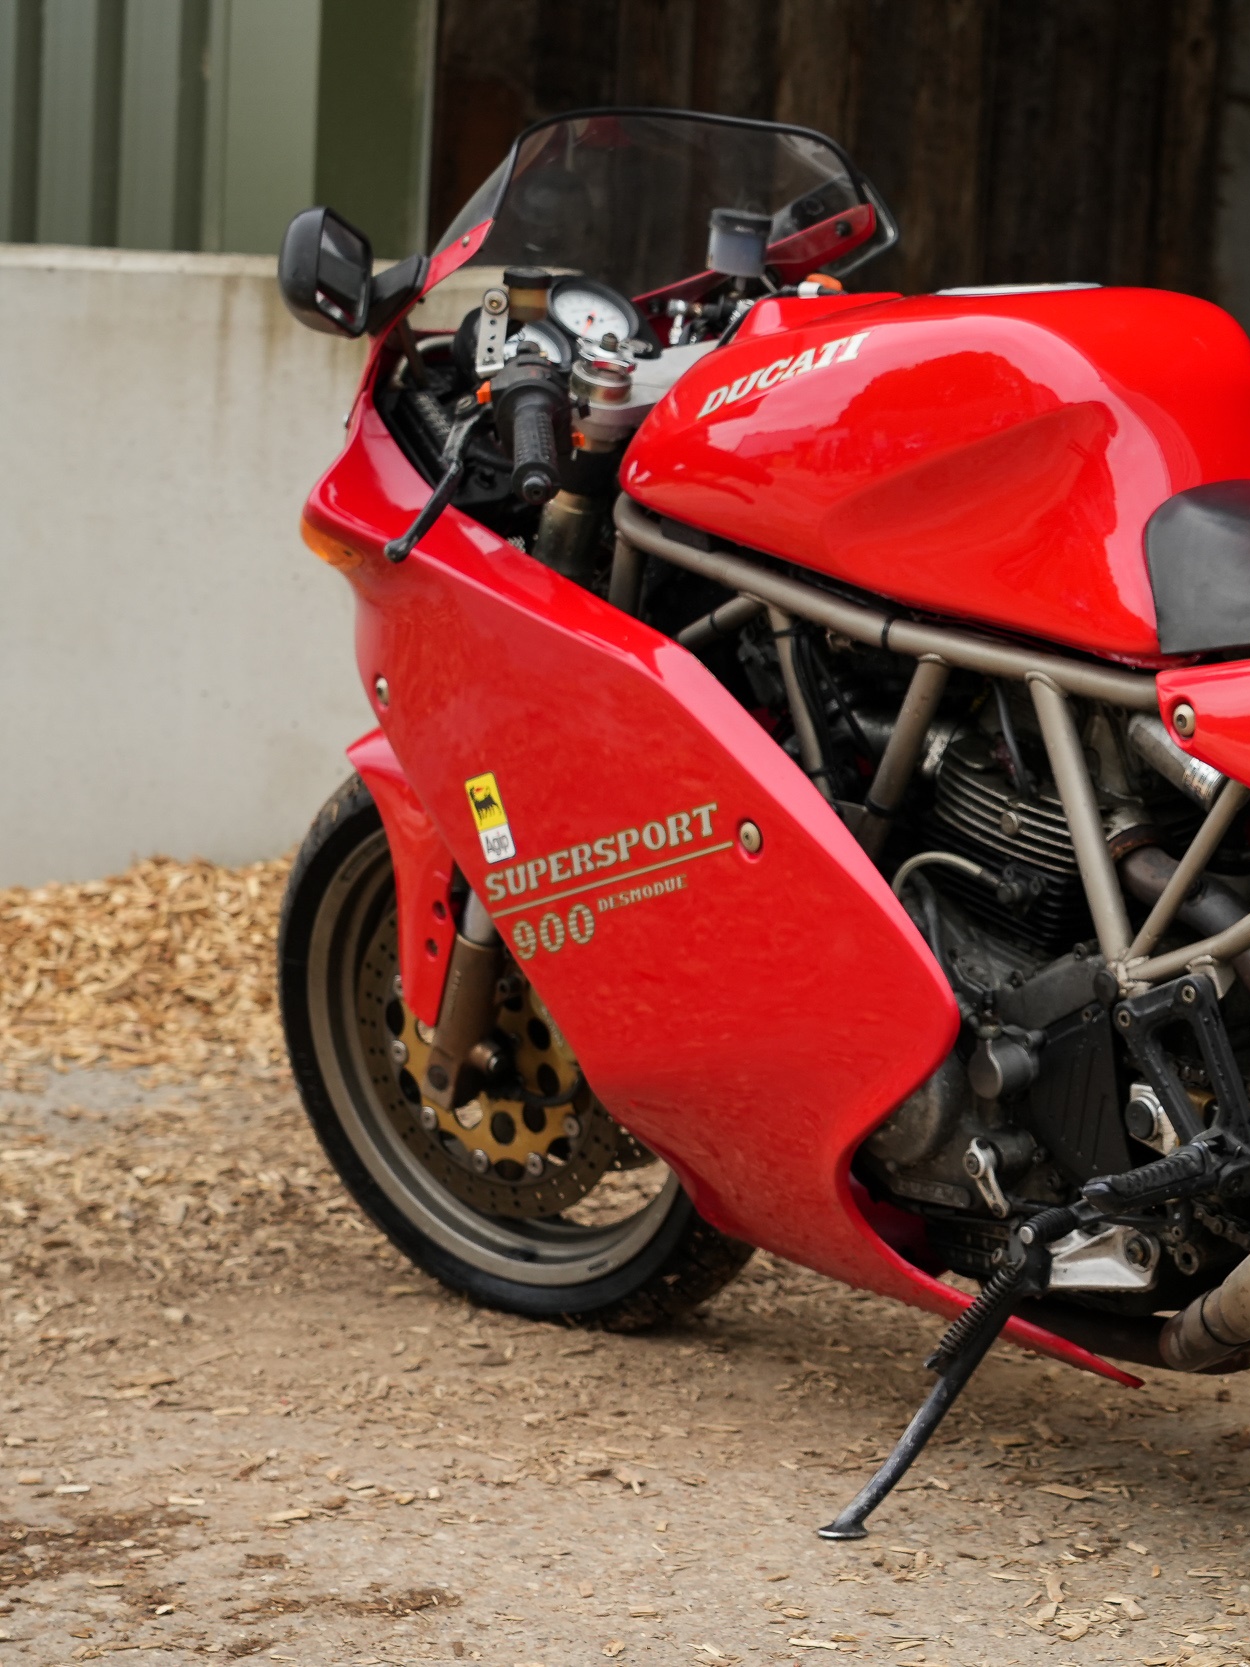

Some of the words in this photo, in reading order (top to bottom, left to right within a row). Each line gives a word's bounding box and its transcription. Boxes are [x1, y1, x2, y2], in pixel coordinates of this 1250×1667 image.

[696, 332, 870, 419] DUCATI
[484, 802, 719, 904] SUPERSPORT
[597, 873, 688, 913] DESMODUE
[511, 903, 596, 961] 900
